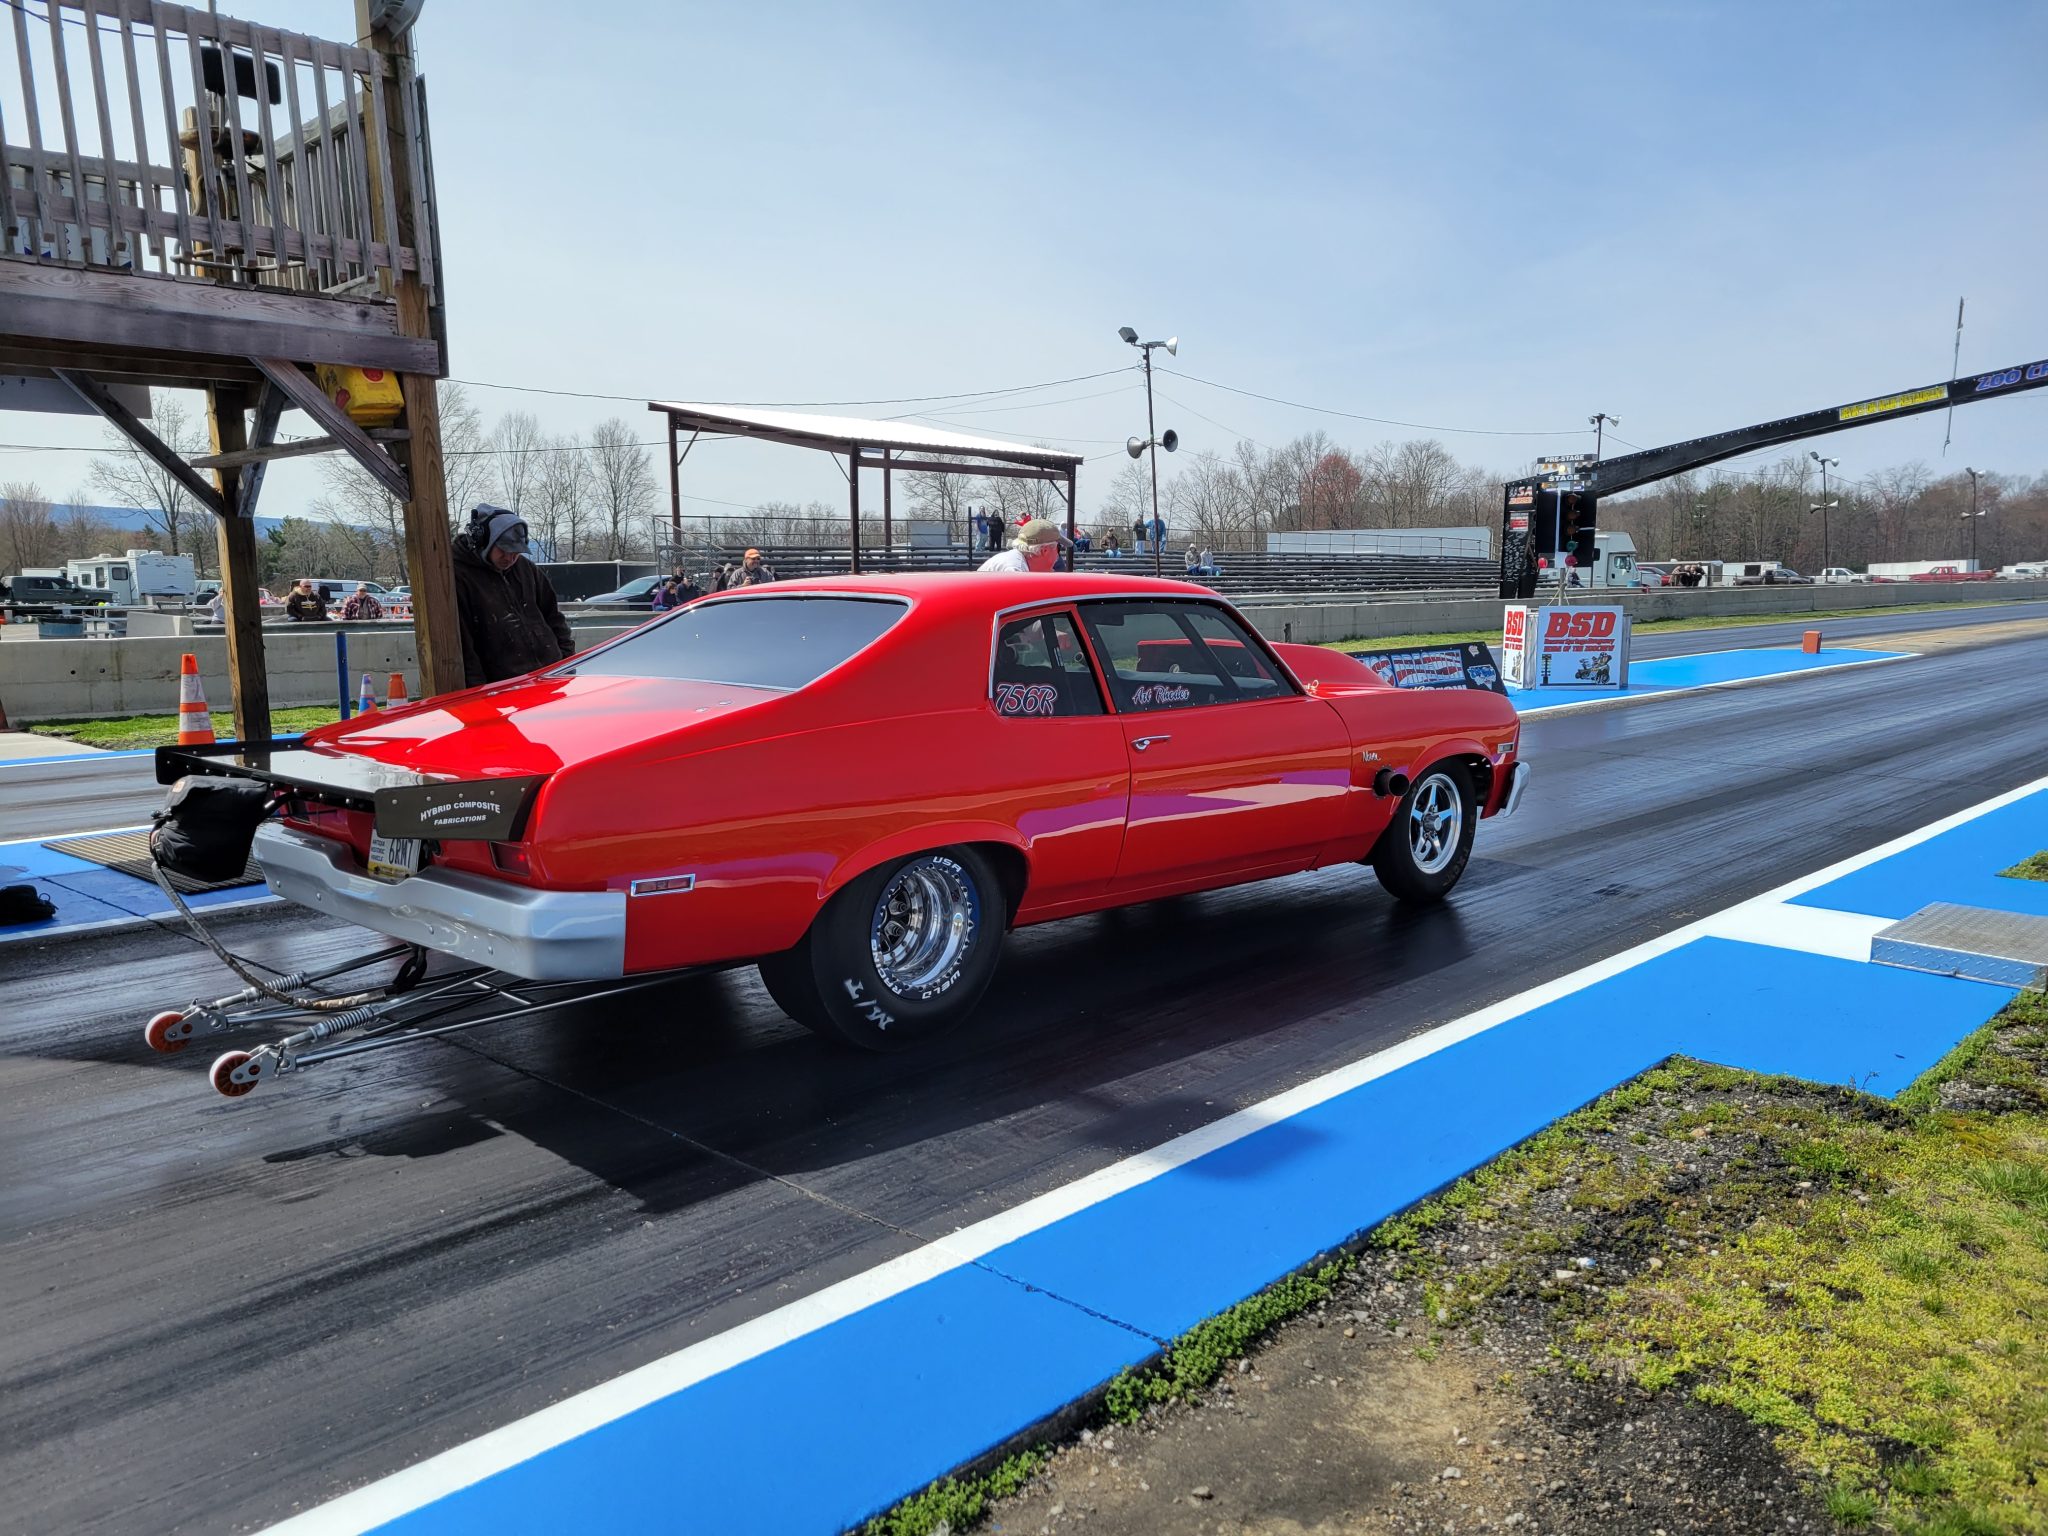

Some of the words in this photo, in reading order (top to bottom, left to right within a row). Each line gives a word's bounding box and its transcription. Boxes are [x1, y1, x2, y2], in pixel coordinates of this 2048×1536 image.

[1976, 370, 2021, 391] ZOO
[1544, 454, 1585, 463] PRE-STAGE
[1548, 474, 1580, 482] STAGE
[1506, 611, 1524, 636] BSD
[1545, 612, 1616, 637] BSD
[996, 683, 1057, 714] 756R
[420, 804, 452, 822] HYBRID
[454, 801, 501, 814] COMPOSITE
[434, 815, 487, 825] FABRICATIONS
[933, 856, 962, 872] USA
[871, 939, 902, 995] RACING
[922, 969, 961, 1000] WELD
